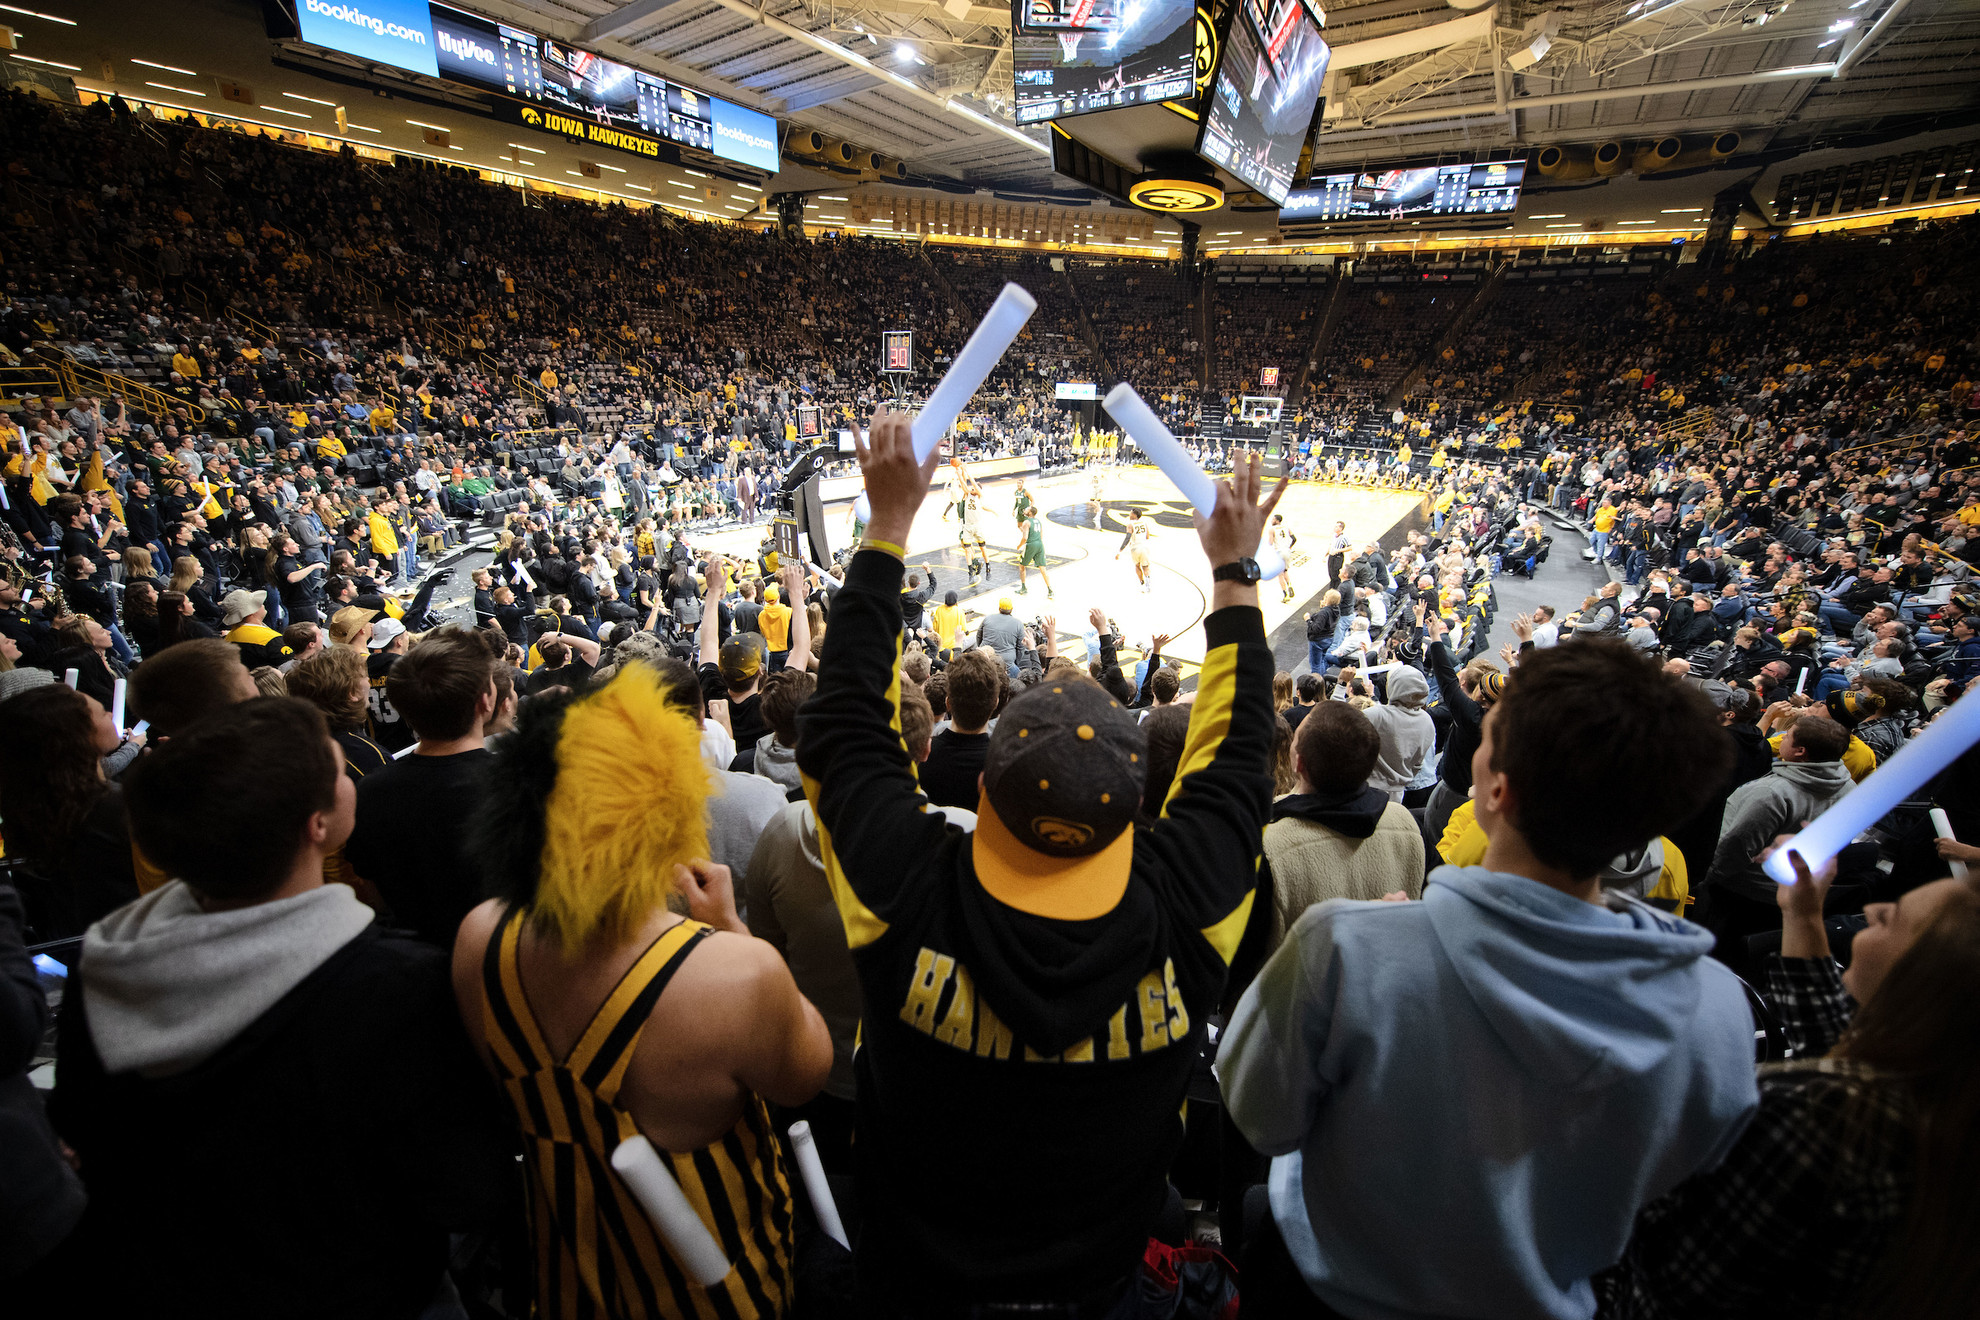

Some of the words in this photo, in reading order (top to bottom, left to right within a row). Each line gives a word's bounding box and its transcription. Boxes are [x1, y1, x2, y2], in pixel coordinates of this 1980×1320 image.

[306, 0, 426, 45] Booking.com
[1079, 100, 1084, 109] 4
[1088, 97, 1109, 108] 17:13
[1129, 91, 1135, 101] 0
[545, 113, 585, 138] IOWA
[588, 124, 658, 156] HAWKEYES
[716, 122, 774, 151] Booking.com
[491, 171, 524, 187] IOWA
[1553, 235, 1590, 246] IOWA
[890, 347, 908, 367] 30
[1264, 375, 1275, 384] 30
[804, 420, 816, 434] 30
[1135, 525, 1146, 535] 25
[900, 947, 1190, 1063] HAWES
